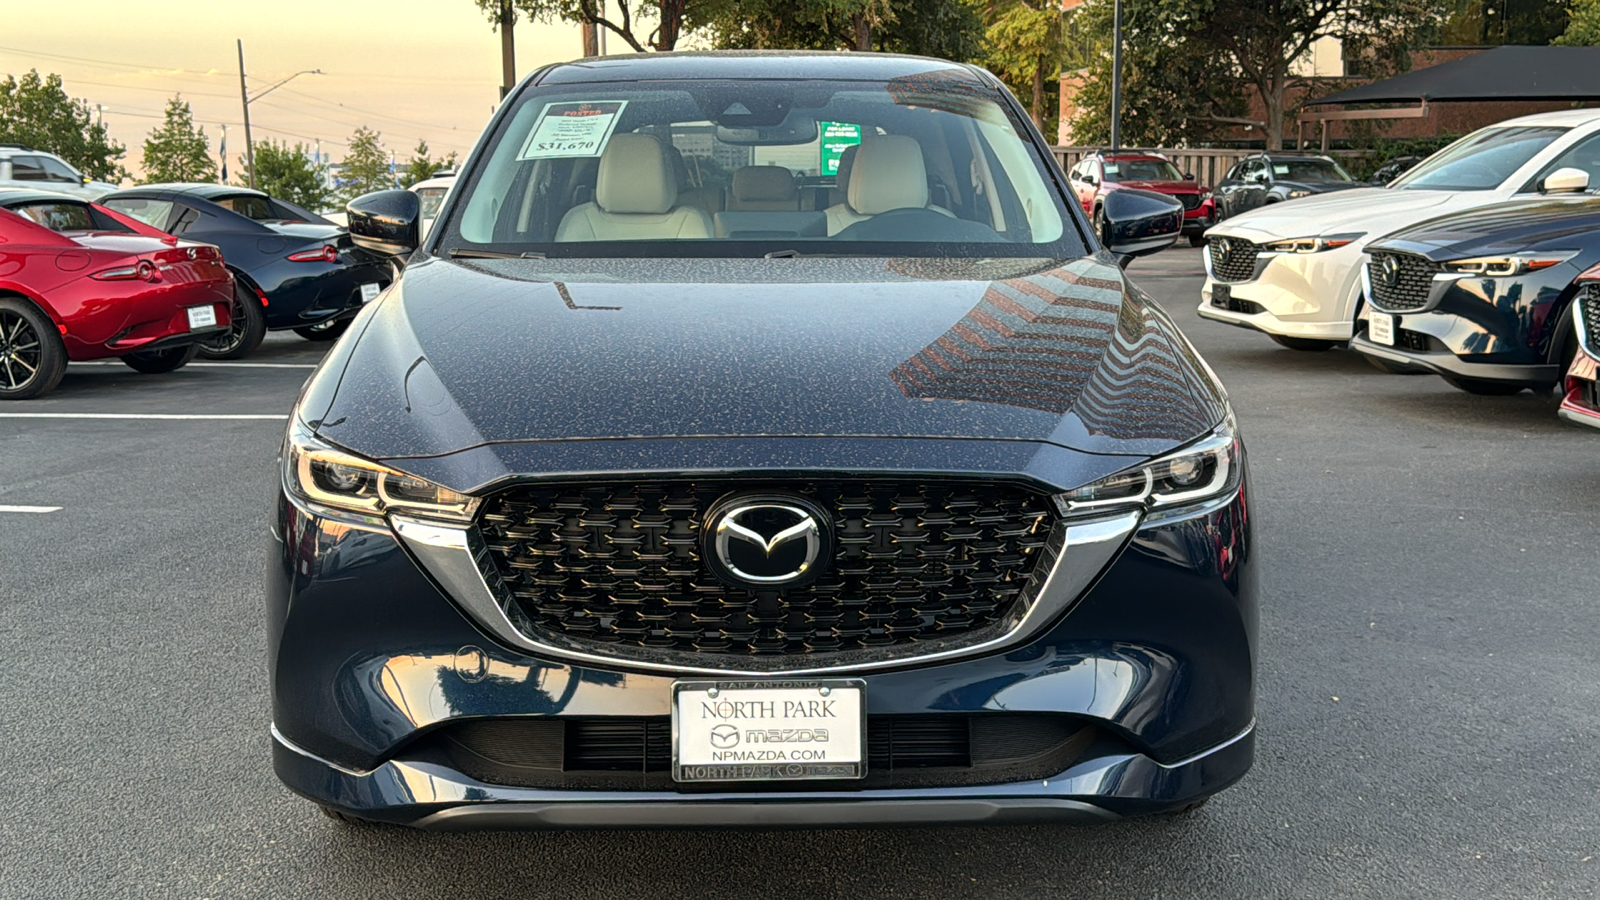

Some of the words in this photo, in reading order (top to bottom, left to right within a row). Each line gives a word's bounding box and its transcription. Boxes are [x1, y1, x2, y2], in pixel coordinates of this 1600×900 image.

[536, 141, 594, 151] $31,670
[752, 681, 819, 689] ANTONIO
[701, 699, 775, 720] NORTH
[783, 700, 837, 718] PARK
[745, 728, 829, 743] mazda
[712, 749, 826, 761] NPMAZDA.COM
[684, 766, 738, 779] NORTH
[741, 765, 784, 778] PARK
